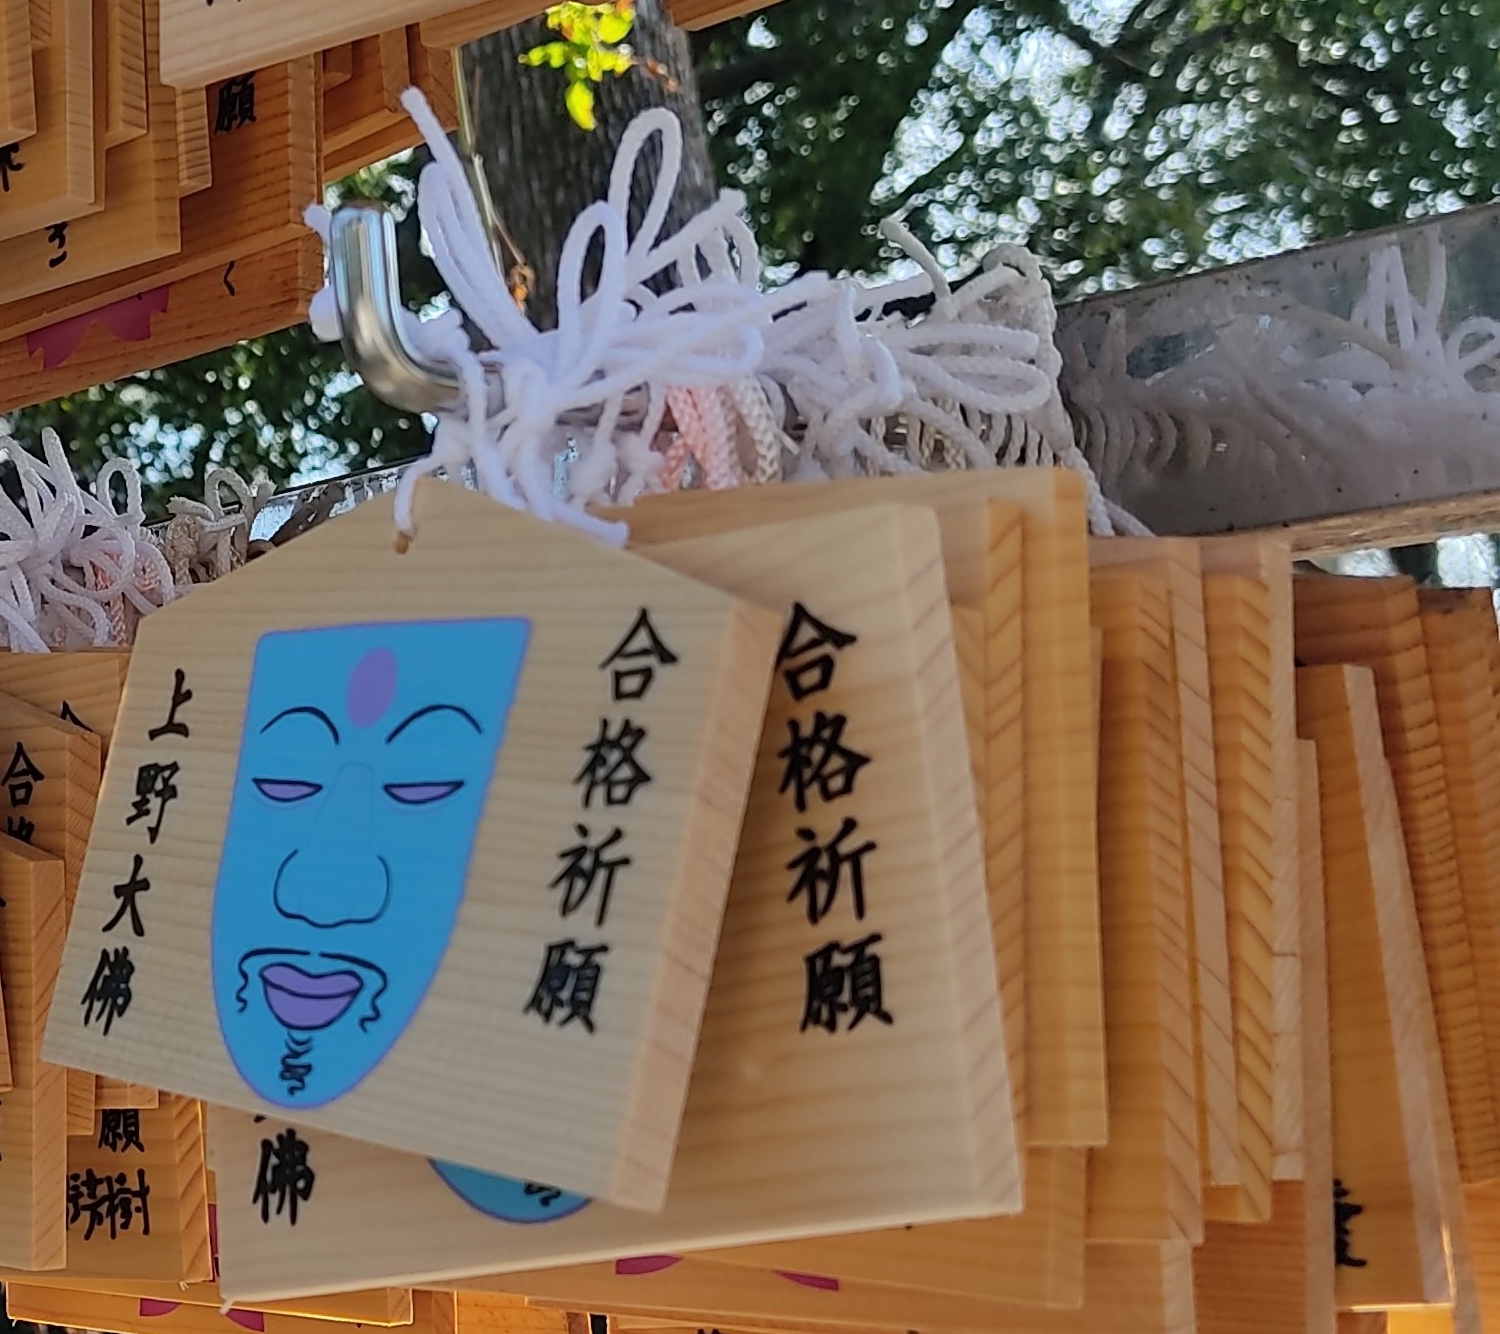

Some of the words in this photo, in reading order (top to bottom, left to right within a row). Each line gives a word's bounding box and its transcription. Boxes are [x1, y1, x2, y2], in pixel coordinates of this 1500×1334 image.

[80, 668, 193, 1037] 上野大佛
[523, 606, 678, 1034] 合格祈願
[774, 602, 894, 1035] 合格祈願
